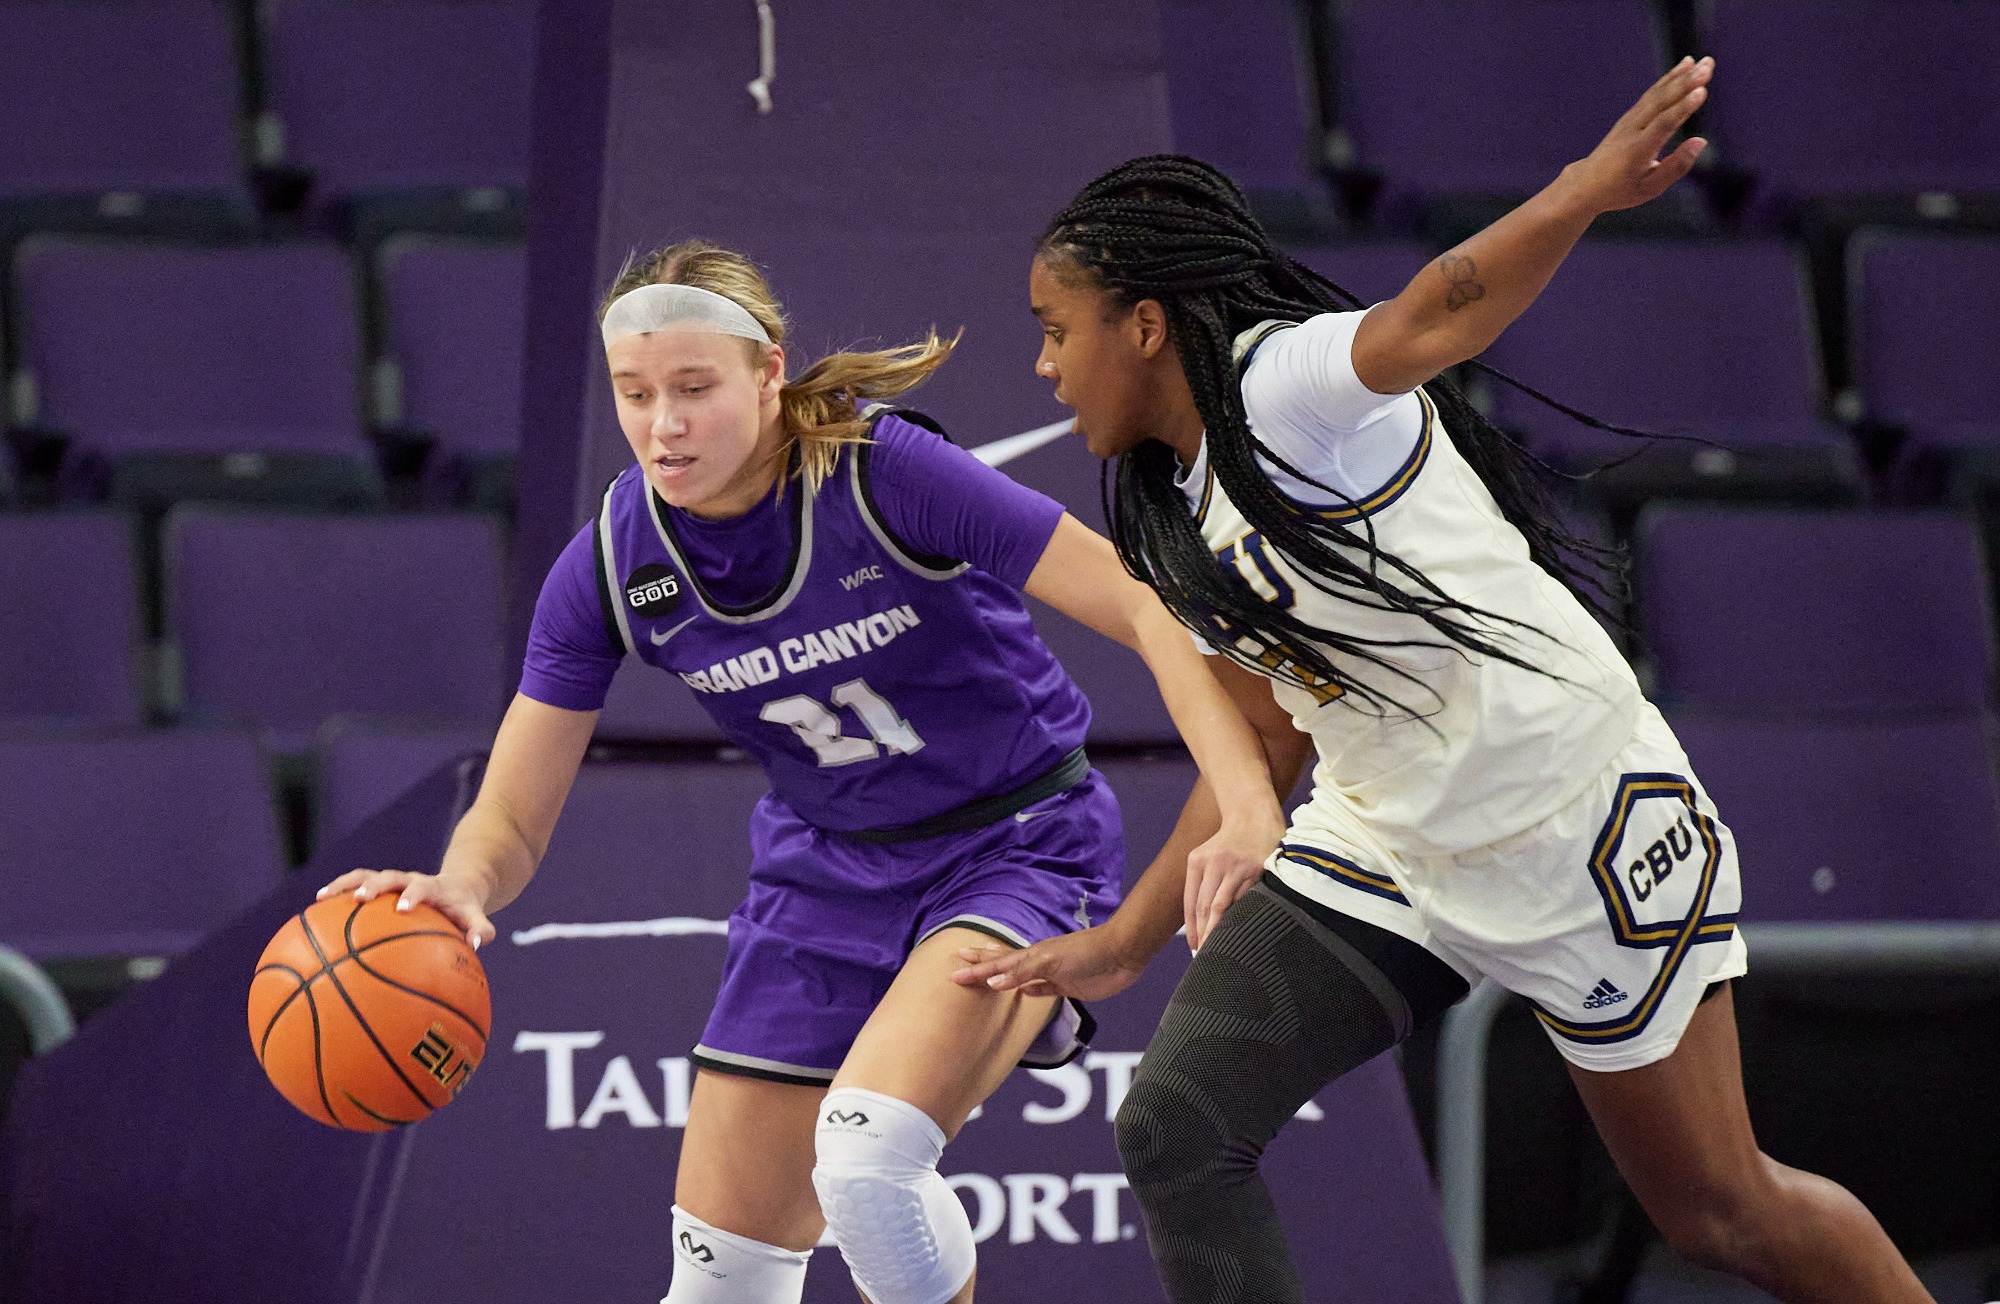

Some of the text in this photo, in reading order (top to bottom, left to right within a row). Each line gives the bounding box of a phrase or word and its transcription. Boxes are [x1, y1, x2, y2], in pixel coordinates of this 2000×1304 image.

[629, 580, 679, 607] GOD
[838, 564, 884, 591] WAC
[778, 603, 922, 675] CANYON
[758, 676, 927, 768] 21
[1628, 815, 1693, 903] CBU
[1582, 990, 1629, 1011] adidas
[409, 1029, 473, 1095] ELIT
